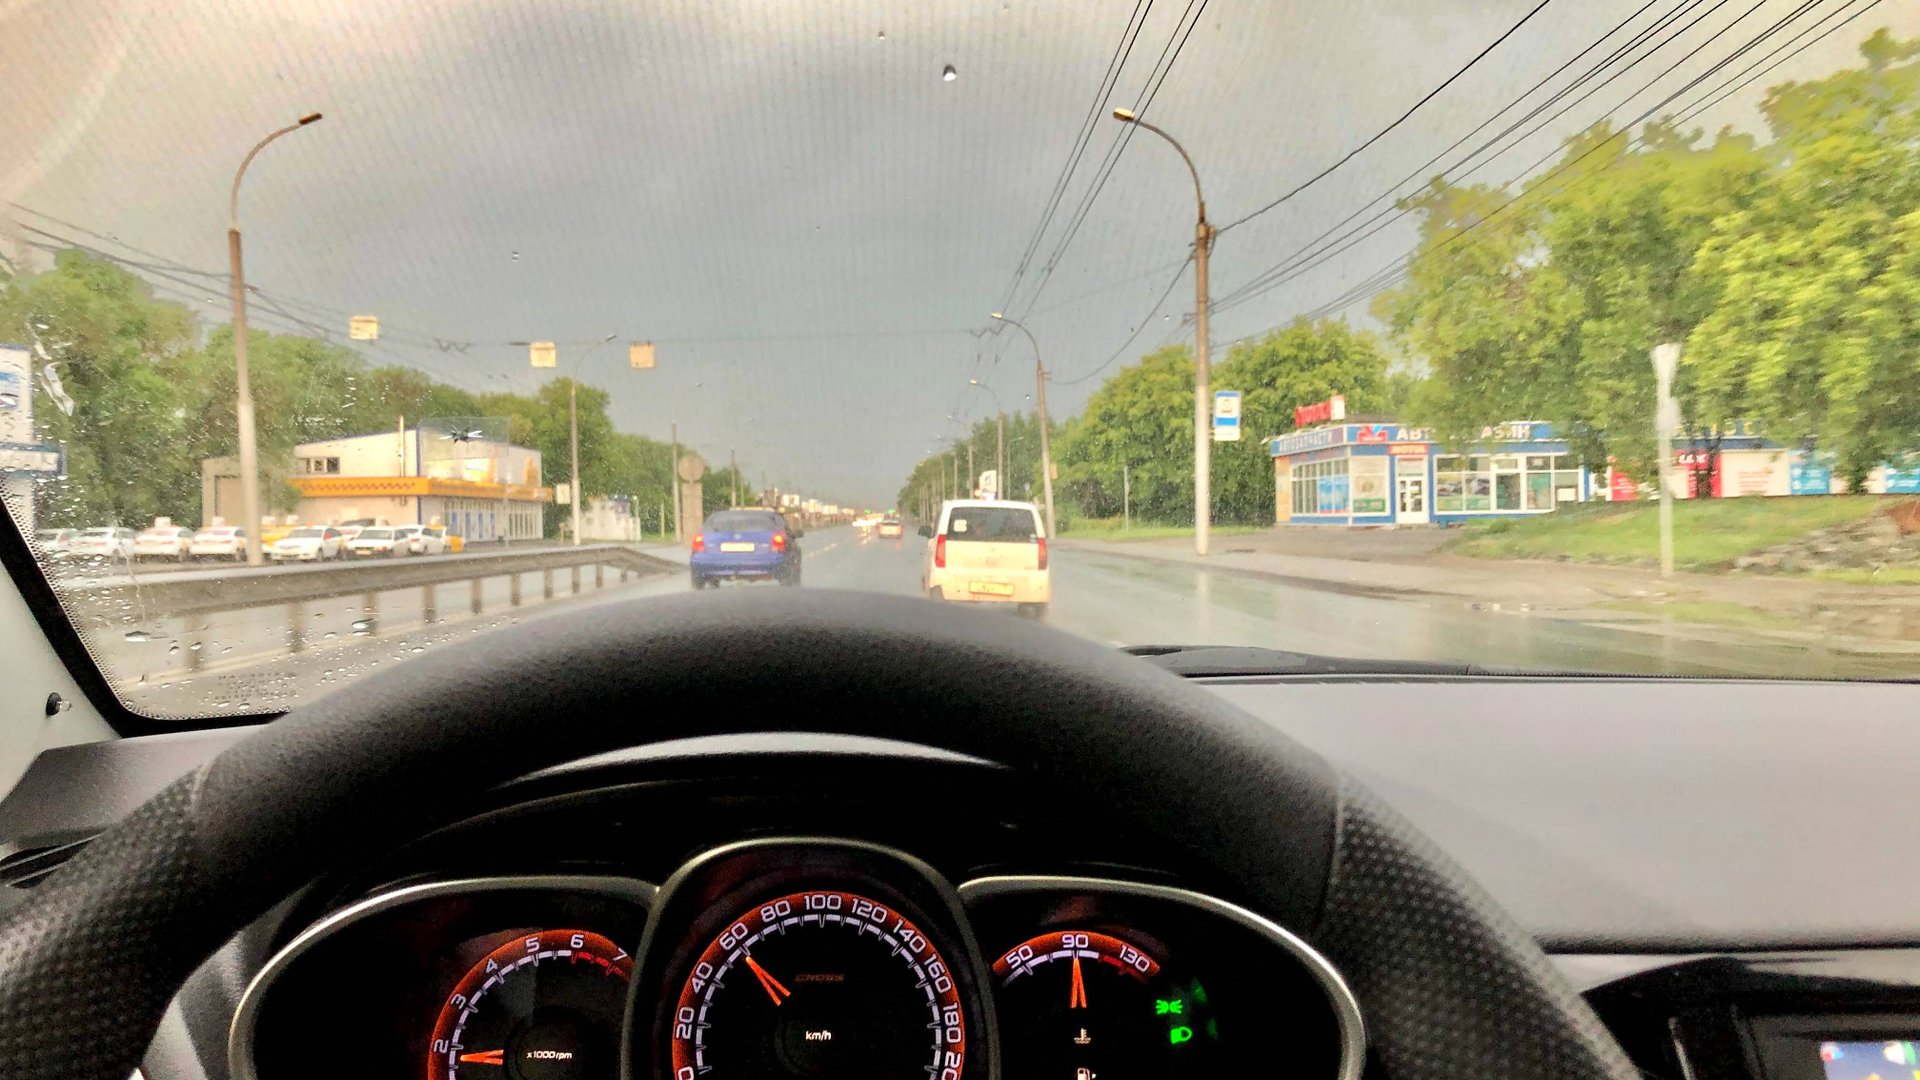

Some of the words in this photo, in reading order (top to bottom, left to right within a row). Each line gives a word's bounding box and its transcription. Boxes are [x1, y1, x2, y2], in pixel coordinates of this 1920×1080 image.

[760, 900, 792, 923] 80
[804, 895, 842, 911] 100
[851, 898, 888, 924] 120
[525, 937, 540, 954] 5
[570, 934, 585, 950] 6
[719, 923, 749, 951] 60
[892, 920, 927, 954] 140
[1062, 934, 1089, 949] 90
[611, 947, 629, 962] 7
[1005, 945, 1034, 970] 50
[1119, 945, 1151, 974] 130
[484, 959, 498, 974] 4
[691, 962, 713, 994] 40
[923, 953, 952, 994] 160
[450, 993, 467, 1009] 3
[676, 1006, 695, 1040] 20
[942, 1002, 962, 1043] 180
[433, 1039, 450, 1054] 2
[805, 1030, 832, 1041] km/h
